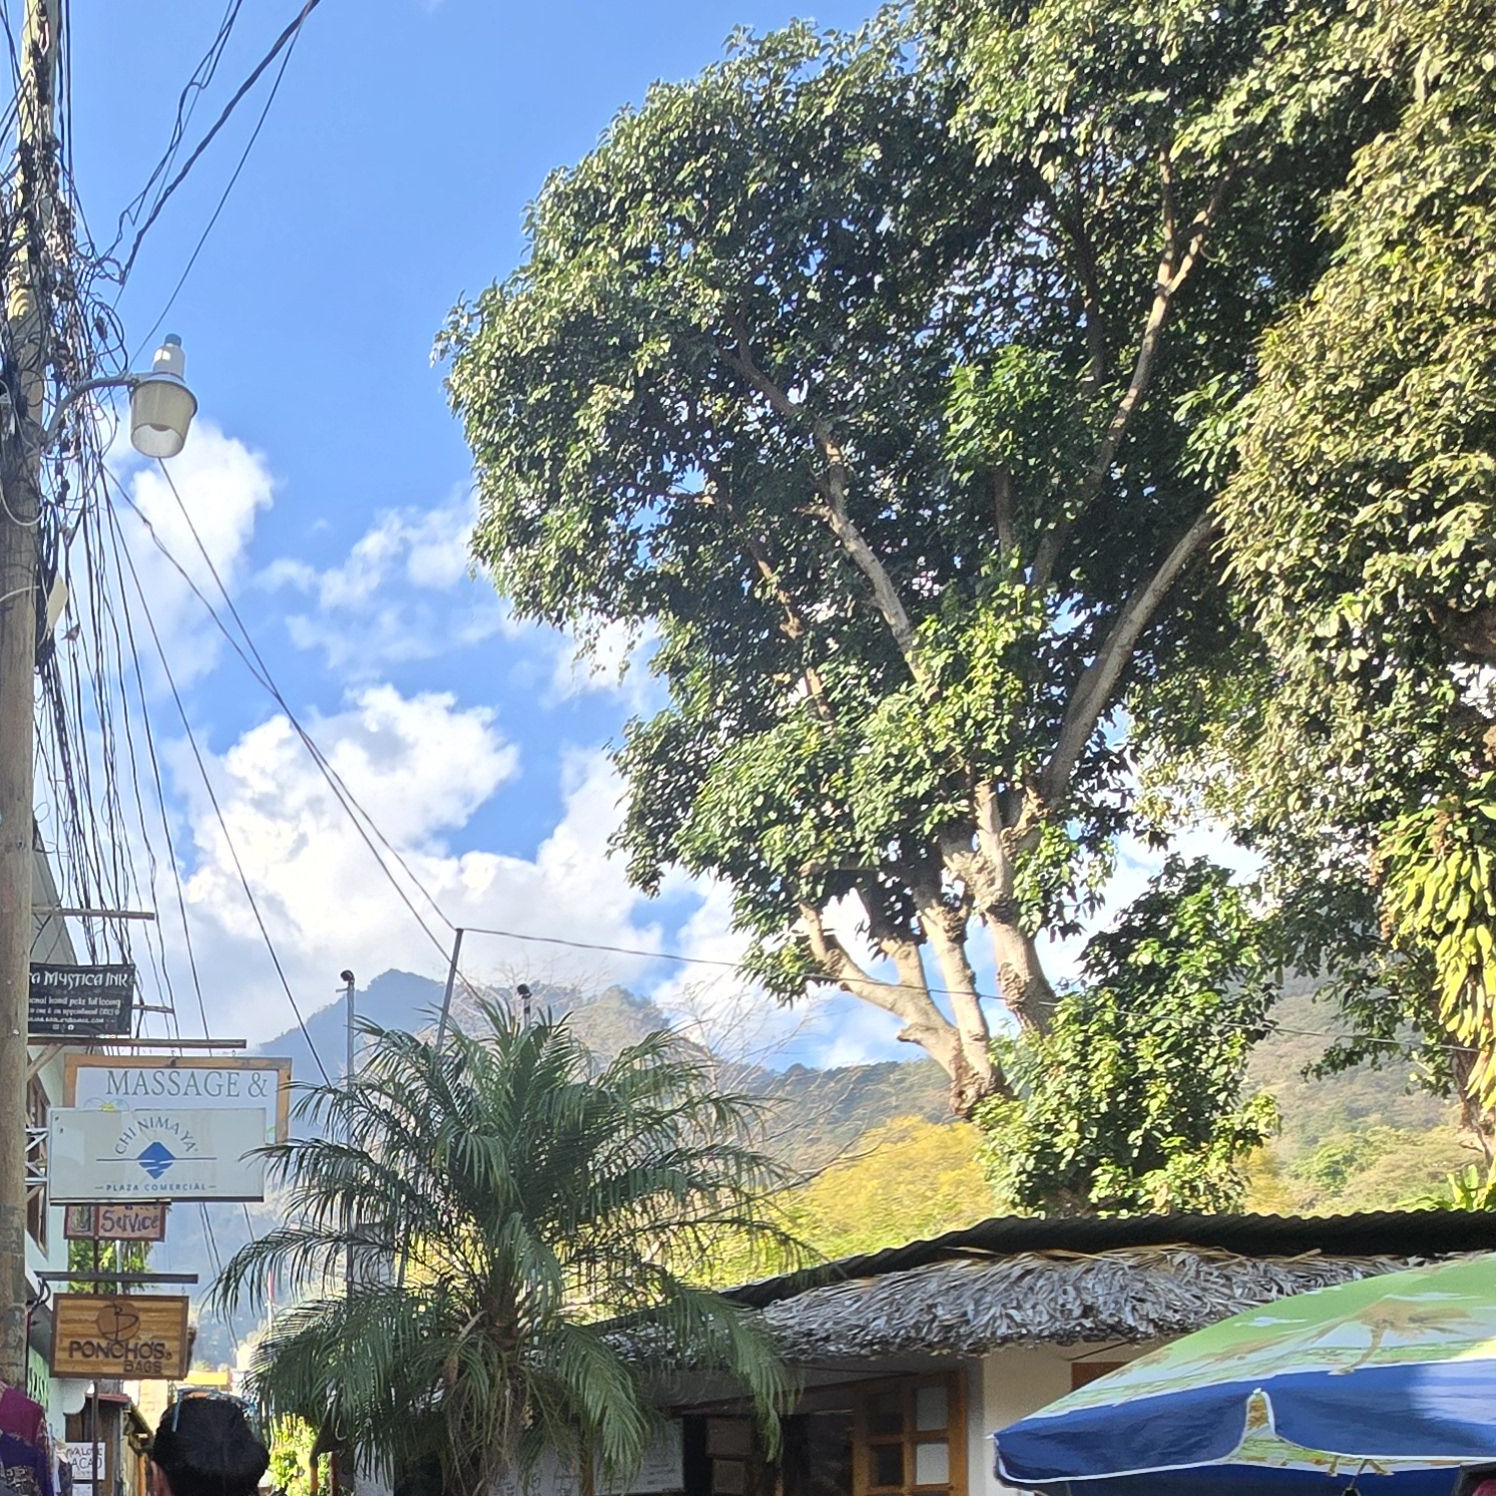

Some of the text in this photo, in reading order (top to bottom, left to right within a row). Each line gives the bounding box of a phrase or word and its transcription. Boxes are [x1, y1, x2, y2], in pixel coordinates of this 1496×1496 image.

[106, 1070, 268, 1097] MASSAGE &
[106, 1183, 206, 1192] PLAZA COMERCIAL
[101, 1210, 160, 1233] Service
[123, 1360, 162, 1373] BAGS
